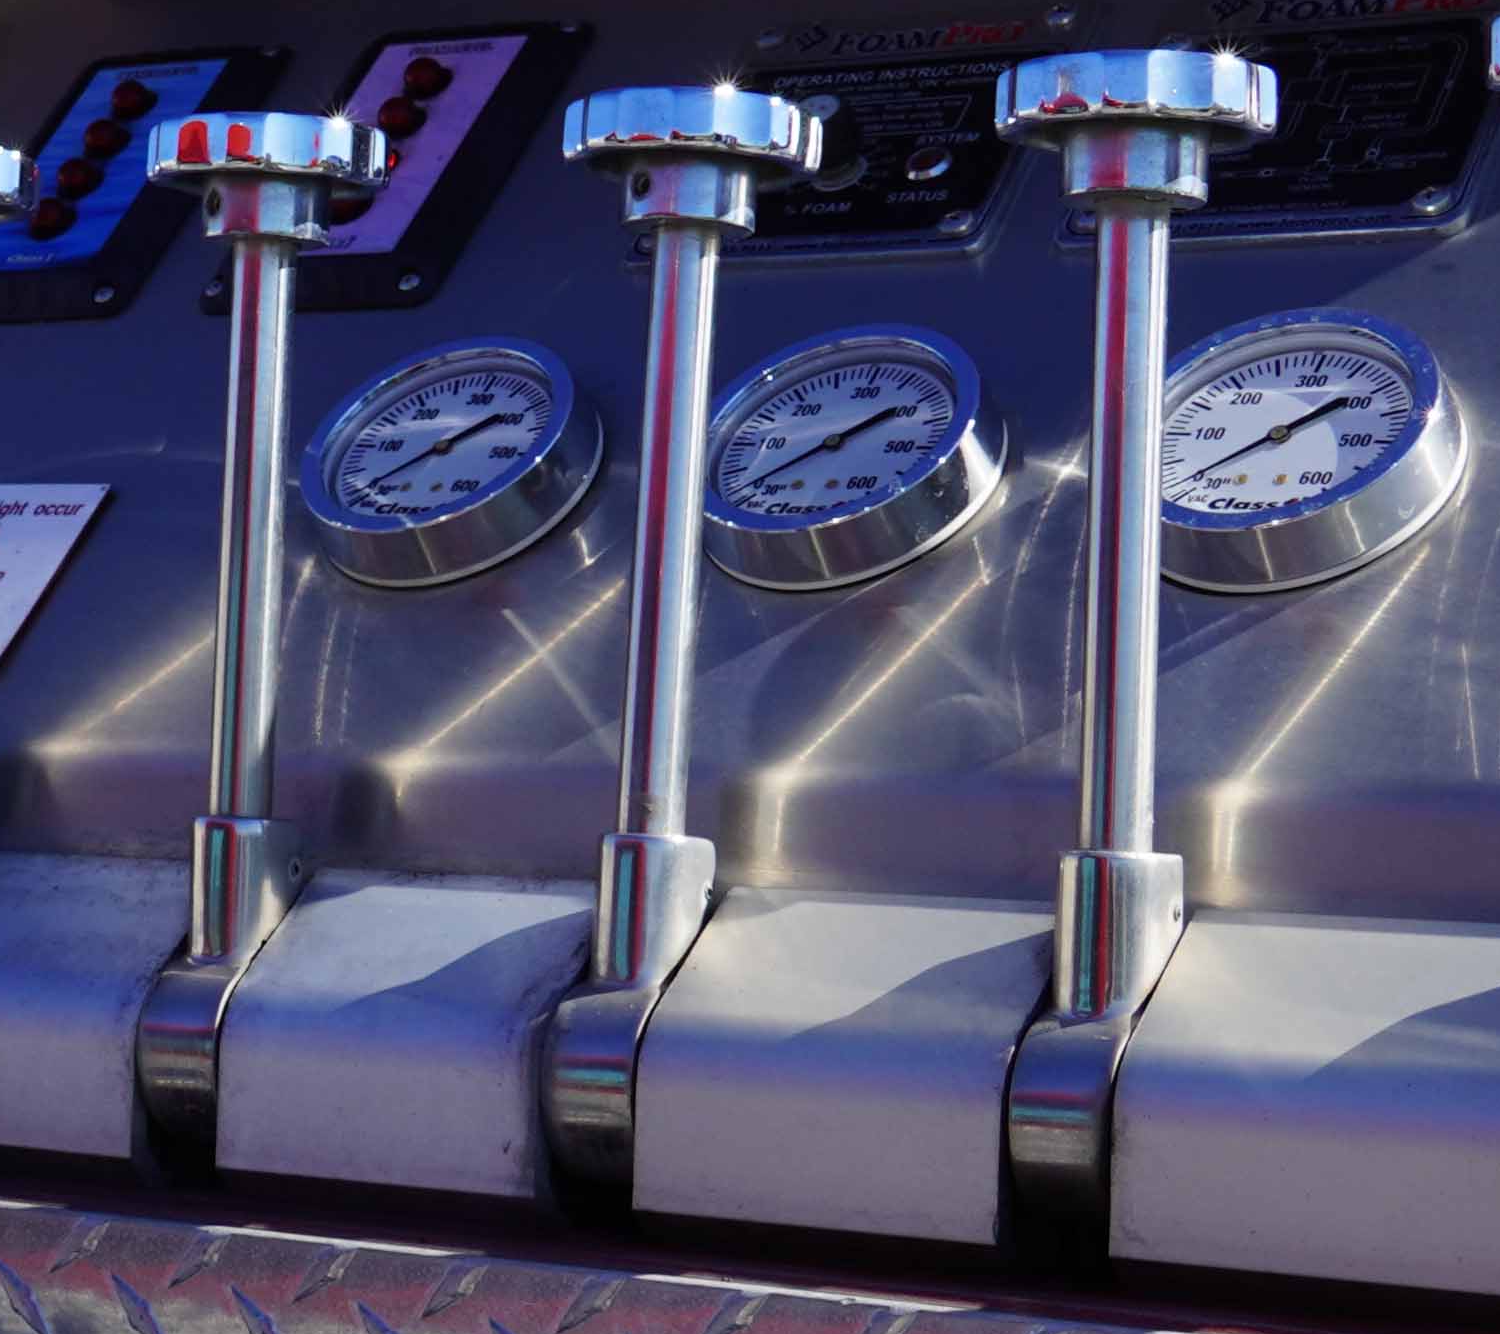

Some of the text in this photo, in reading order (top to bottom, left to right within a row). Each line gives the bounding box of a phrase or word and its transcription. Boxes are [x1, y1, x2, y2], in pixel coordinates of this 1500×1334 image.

[774, 61, 1012, 89] OPERATING INSTRUCTIONS
[916, 131, 982, 145] SYSTEM
[885, 189, 950, 204] STATUS
[800, 201, 856, 215] FOAM
[1295, 374, 1328, 388] 300
[466, 392, 495, 406] 300
[851, 386, 880, 399] 300
[1230, 392, 1262, 405] 200
[412, 408, 441, 420] 200
[792, 404, 822, 416] 200
[893, 406, 918, 418] 00
[1195, 427, 1225, 440] 100
[1339, 432, 1371, 447] 500
[377, 439, 404, 452] 100
[758, 436, 786, 449] 100
[884, 440, 915, 453] 500
[488, 446, 517, 459] 500
[846, 475, 877, 489] 600
[1203, 477, 1232, 490] 30"
[1299, 471, 1332, 485] 600
[450, 480, 480, 493] 600
[34, 504, 86, 516] occur
[1208, 497, 1279, 510] Class
